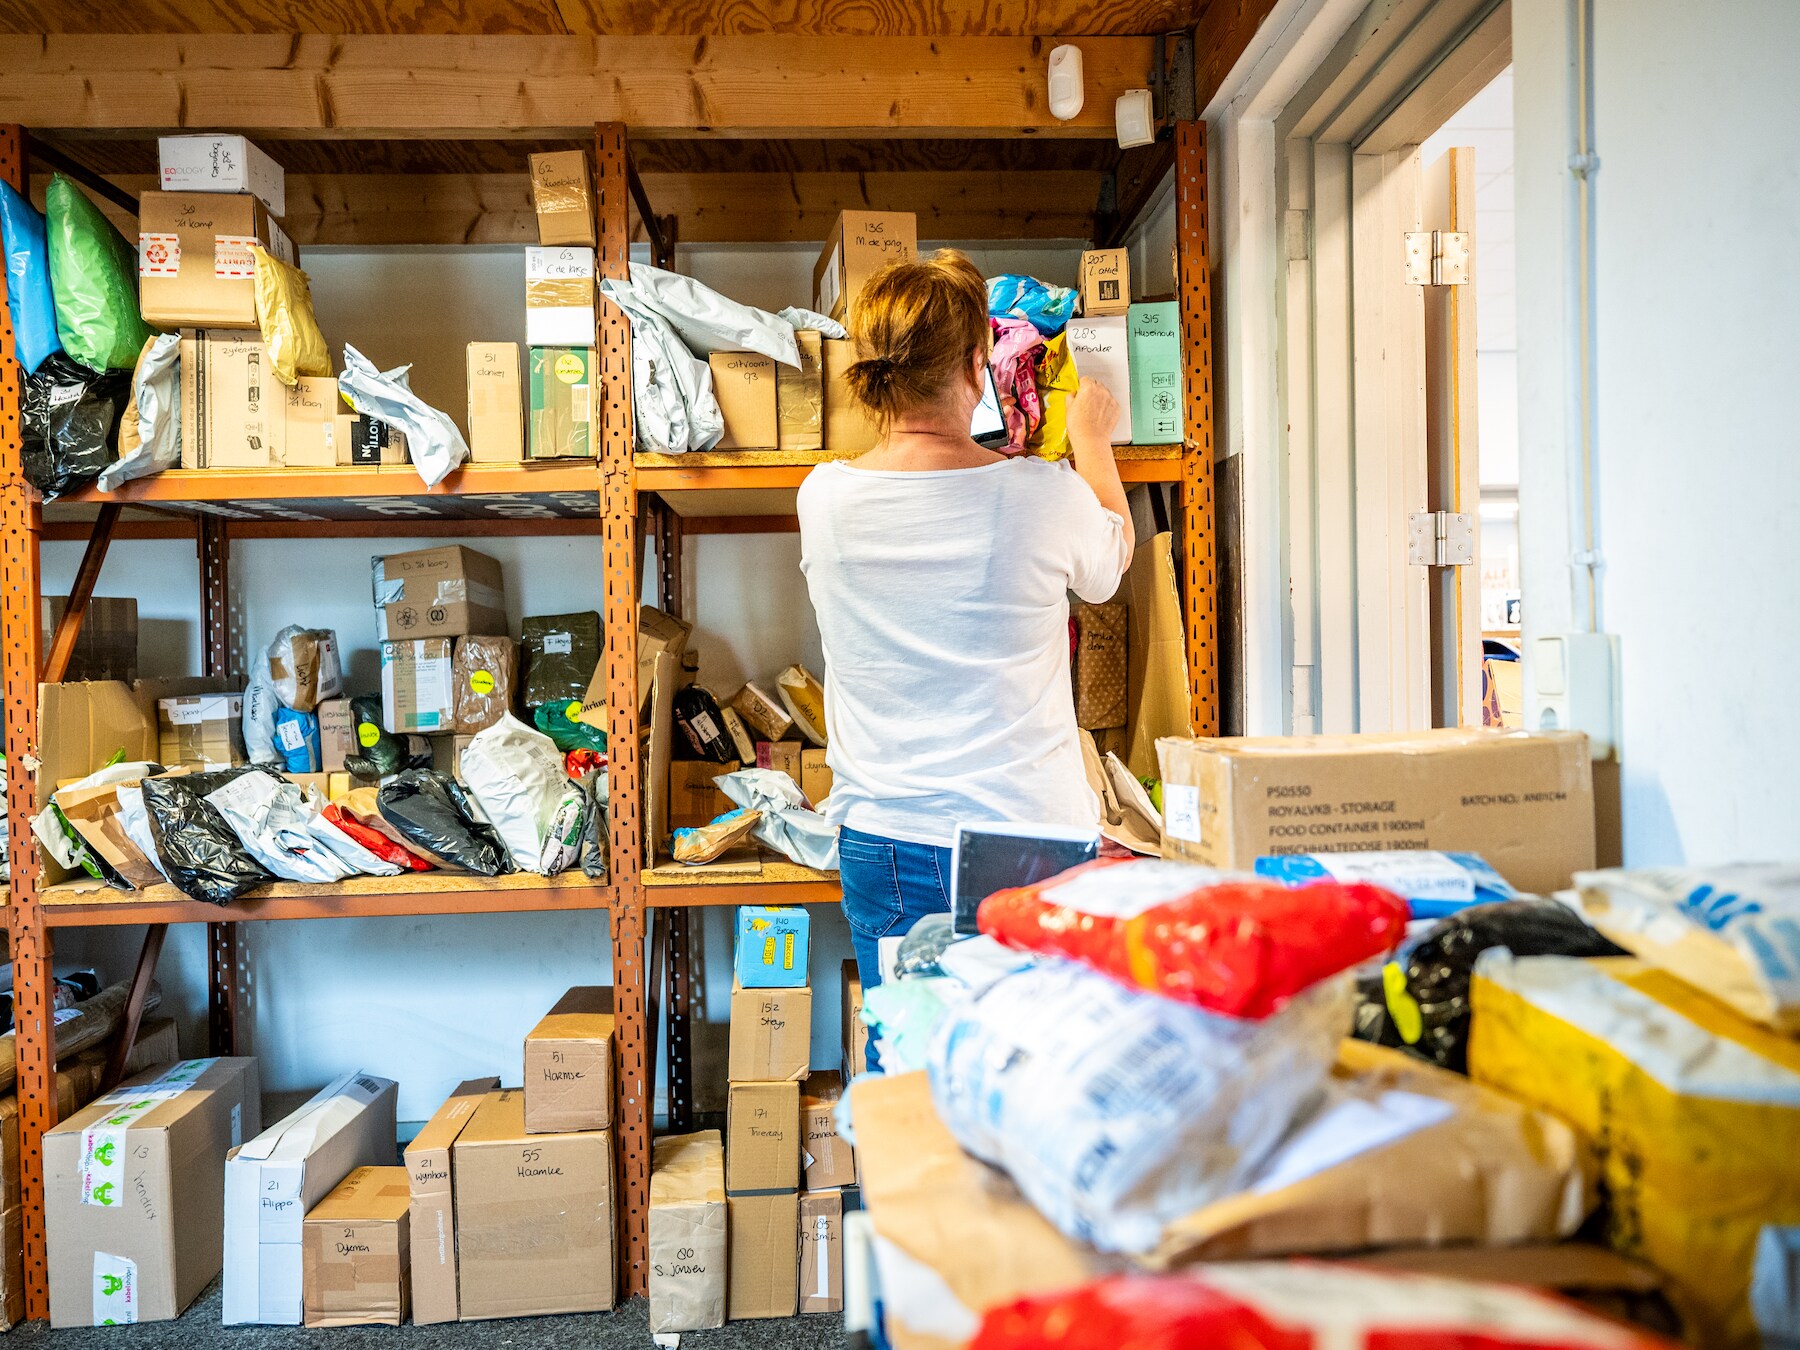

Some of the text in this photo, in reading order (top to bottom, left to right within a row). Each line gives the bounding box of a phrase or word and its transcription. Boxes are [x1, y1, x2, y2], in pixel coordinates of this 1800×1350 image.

[538, 161, 553, 174] 62
[865, 222, 884, 233] 136
[560, 249, 574, 260] 63
[1088, 254, 1107, 265] 205
[1142, 314, 1160, 323] 315
[1072, 327, 1096, 340] 285
[484, 353, 496, 362] 51
[743, 372, 759, 385] 93
[1340, 800, 1396, 815] STORAGE
[1269, 824, 1307, 837] FOOD
[1309, 821, 1379, 836] CONTAINER
[761, 1002, 780, 1013] 152
[552, 1052, 564, 1063] 51
[815, 1116, 829, 1127] 177
[522, 1148, 542, 1162] 55
[421, 1159, 432, 1168] 21
[267, 1181, 279, 1190] 21
[344, 1228, 354, 1238] 21
